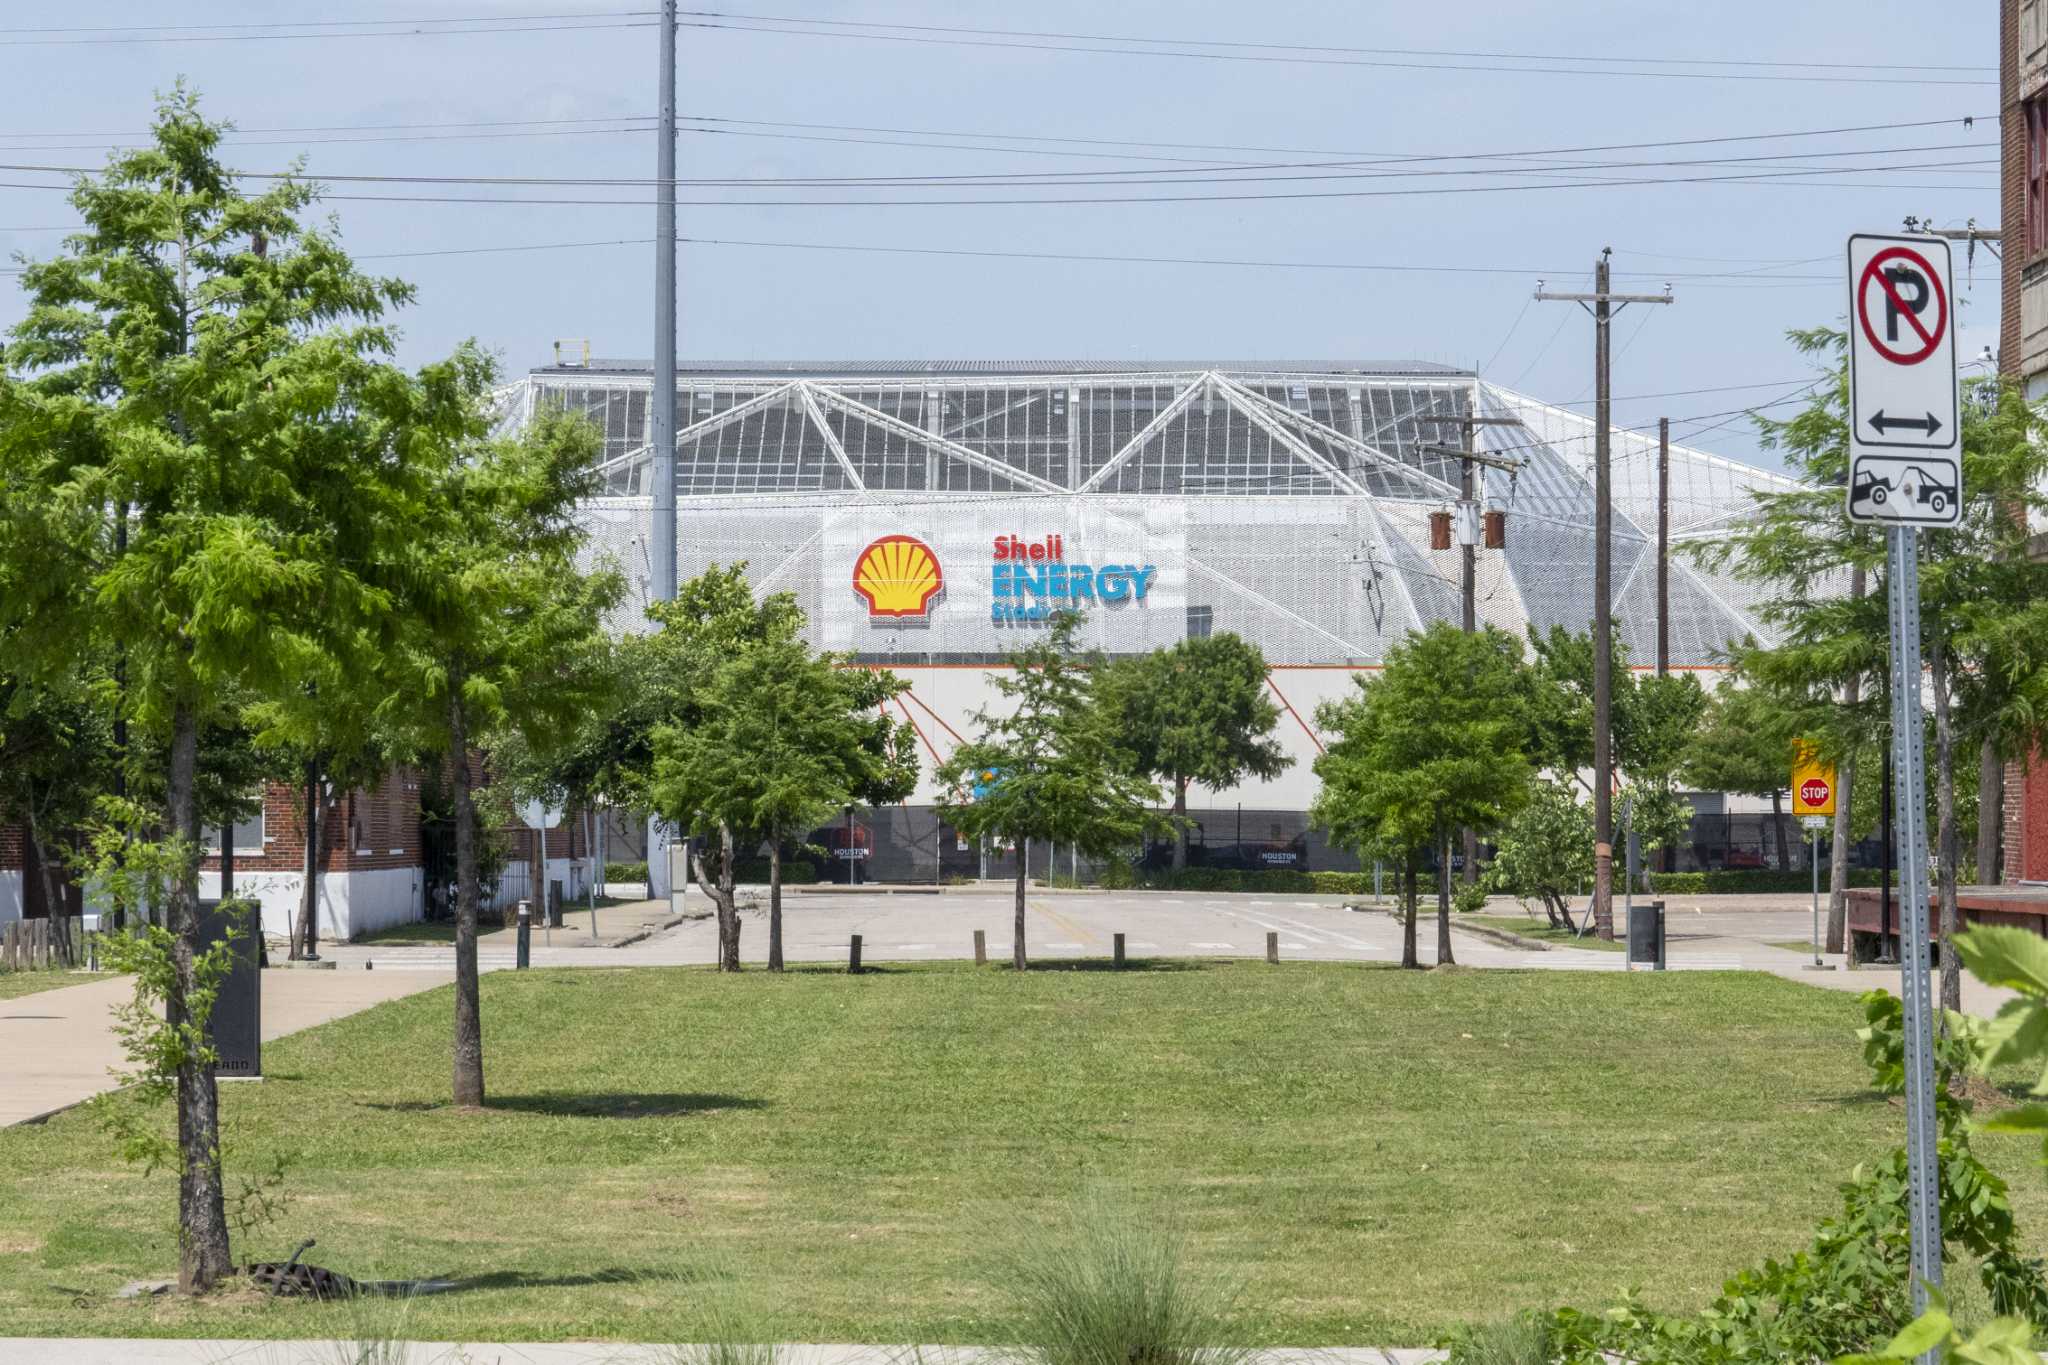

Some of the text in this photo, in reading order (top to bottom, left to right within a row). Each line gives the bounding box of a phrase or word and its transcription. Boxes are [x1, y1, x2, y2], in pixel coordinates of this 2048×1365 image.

[992, 535, 1063, 560] Shell
[992, 564, 1157, 600] ENERGY
[1801, 787, 1828, 799] STOP
[834, 848, 869, 856] HOUSTON
[1262, 852, 1297, 860] HOUSTON
